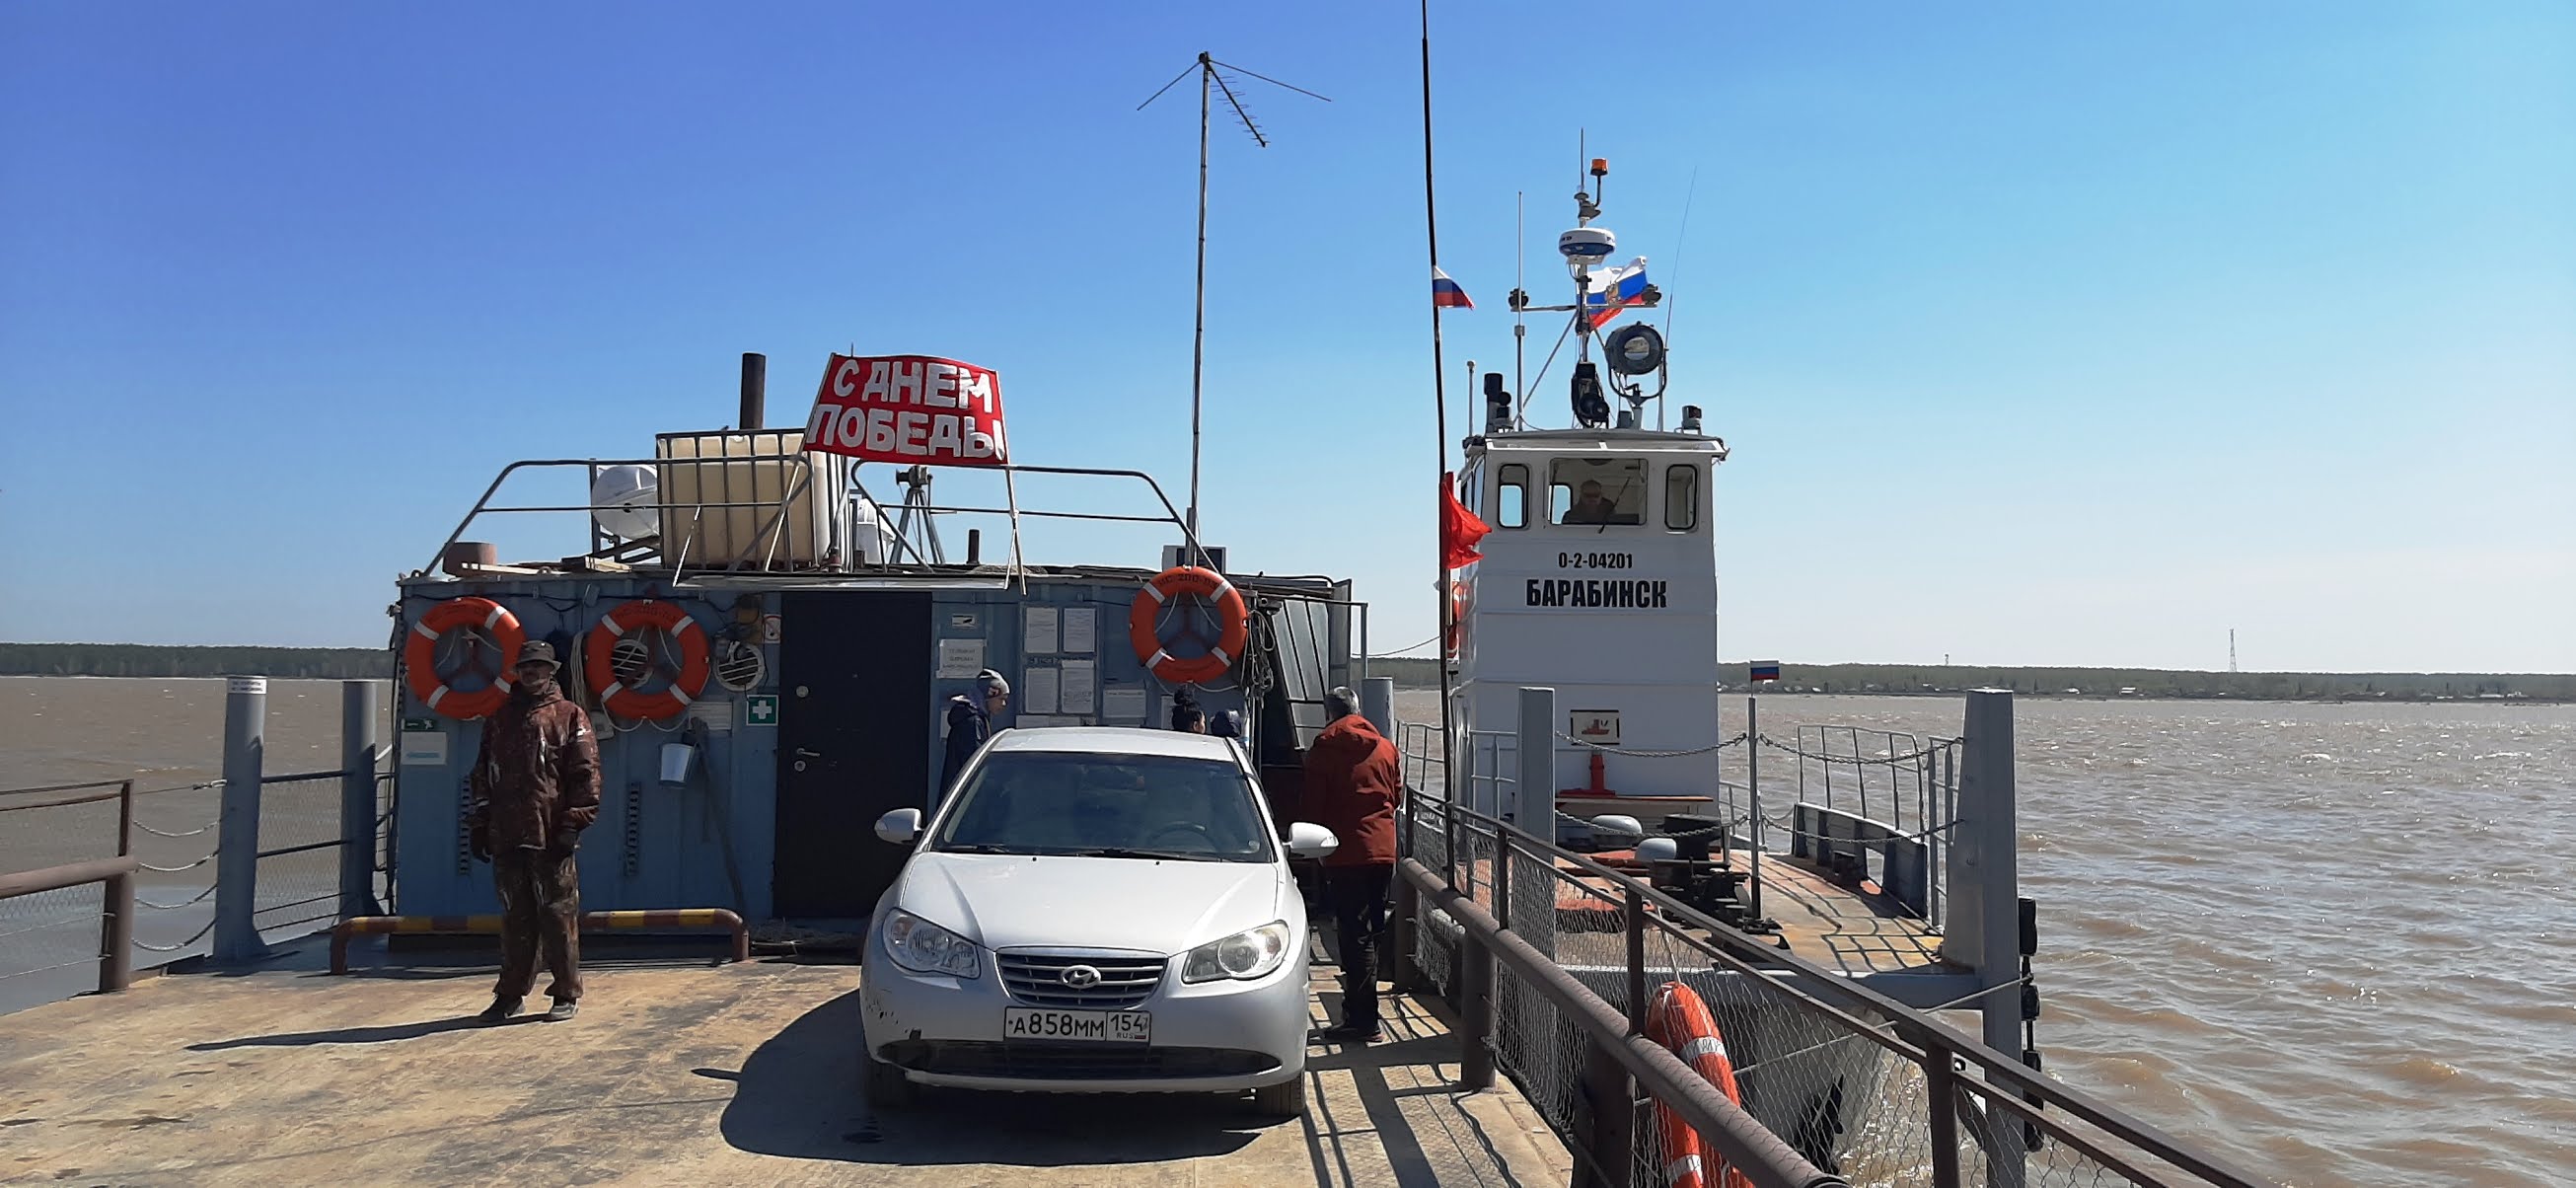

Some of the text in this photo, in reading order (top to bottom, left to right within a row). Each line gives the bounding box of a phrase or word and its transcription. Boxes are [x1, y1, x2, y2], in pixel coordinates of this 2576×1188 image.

[834, 359, 993, 413] С ДНЕМ
[806, 404, 1006, 461] ПОБЕДЫ
[1526, 579, 1667, 608] БАРАБИНСК
[1110, 1013, 1142, 1032] 154
[1116, 1031, 1134, 1040] RUS
